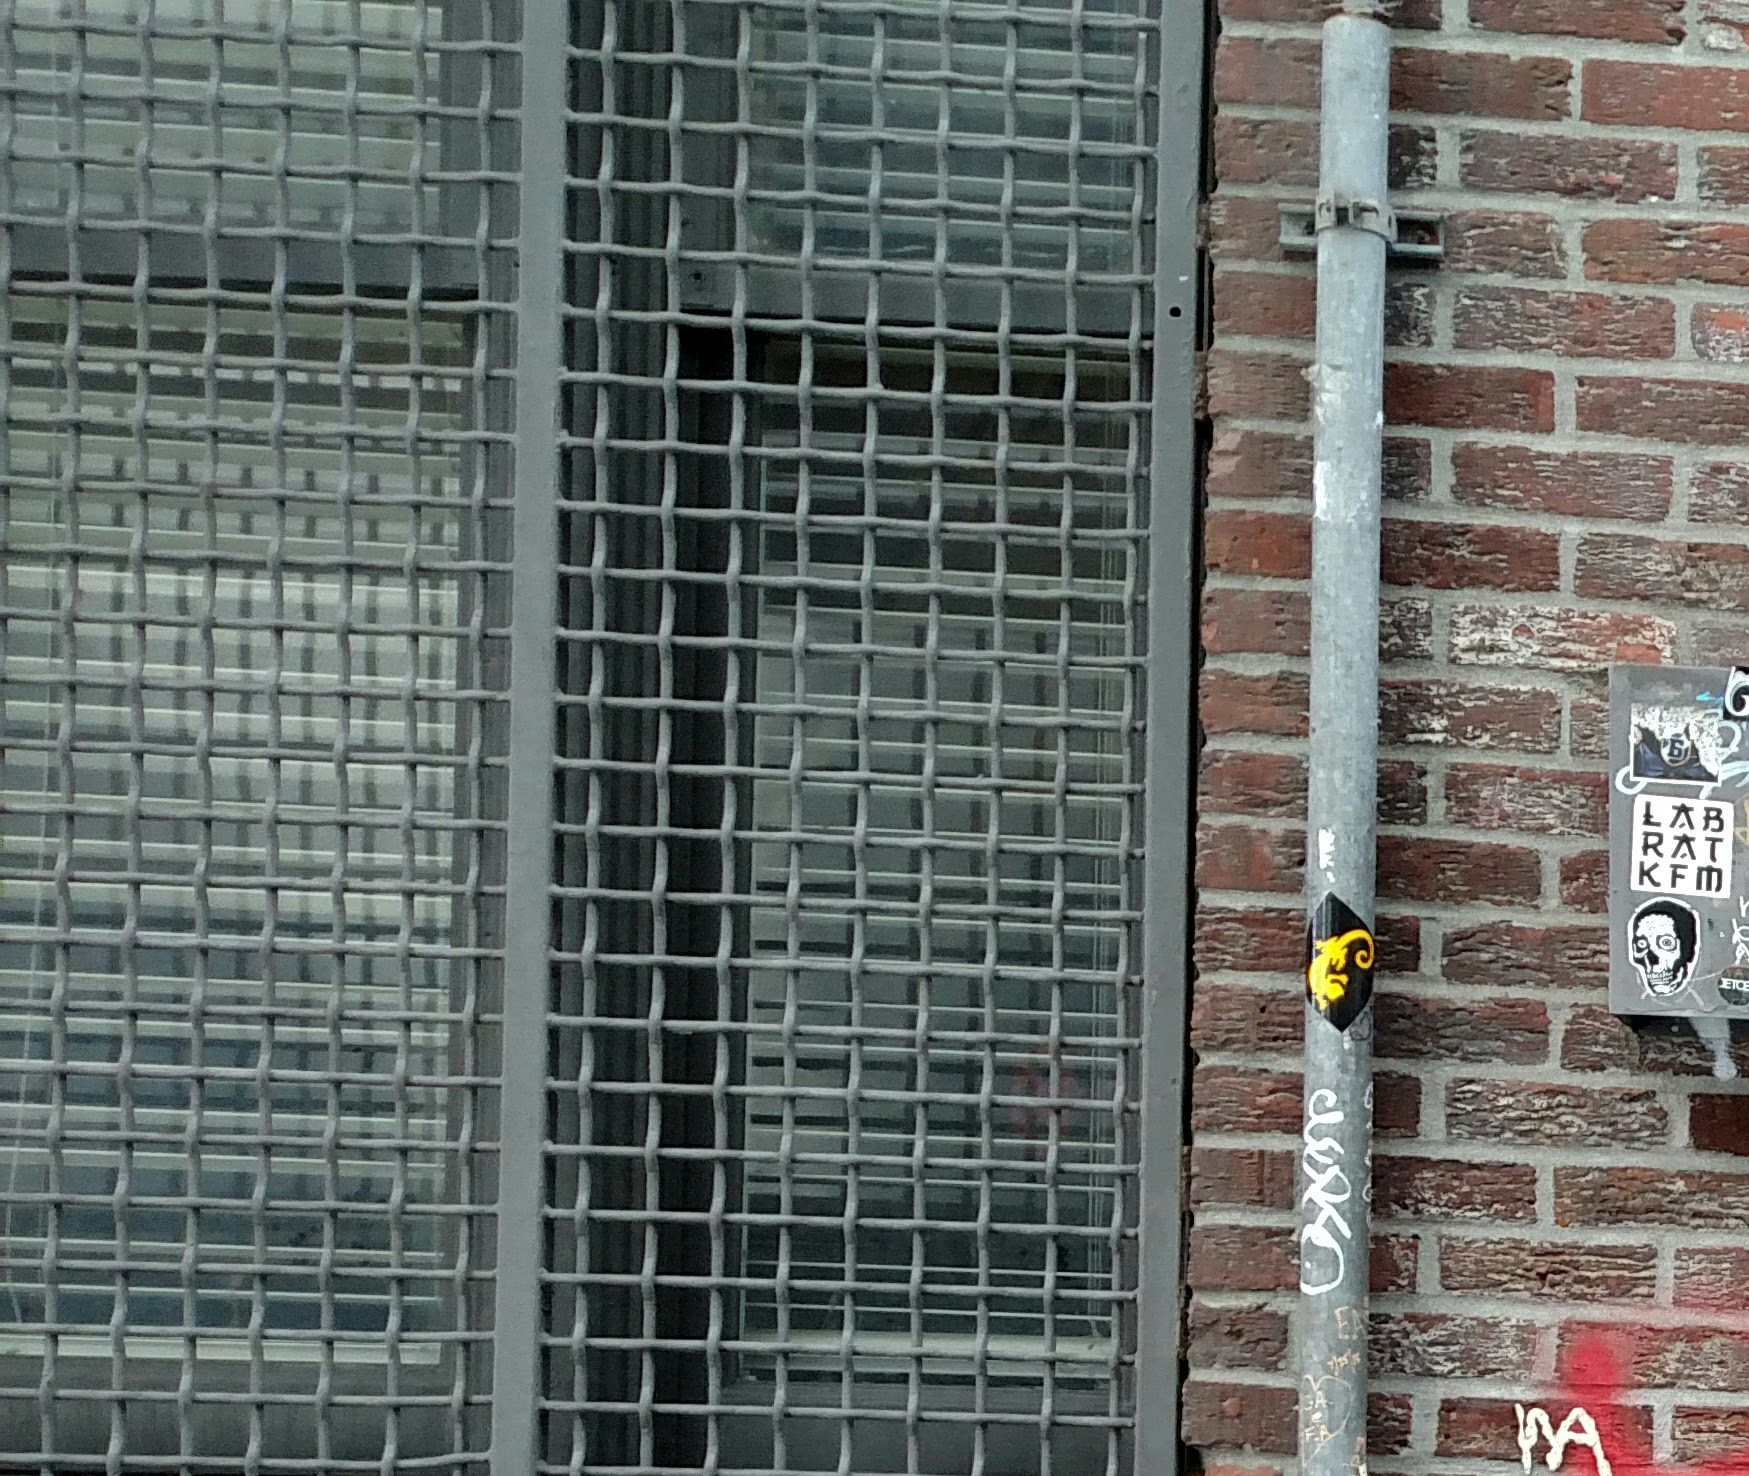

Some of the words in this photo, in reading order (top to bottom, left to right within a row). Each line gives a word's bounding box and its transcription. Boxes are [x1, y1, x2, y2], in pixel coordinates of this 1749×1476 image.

[1642, 801, 1725, 833] LAB
[1642, 831, 1724, 863] RAT
[1638, 861, 1723, 893] KFM
